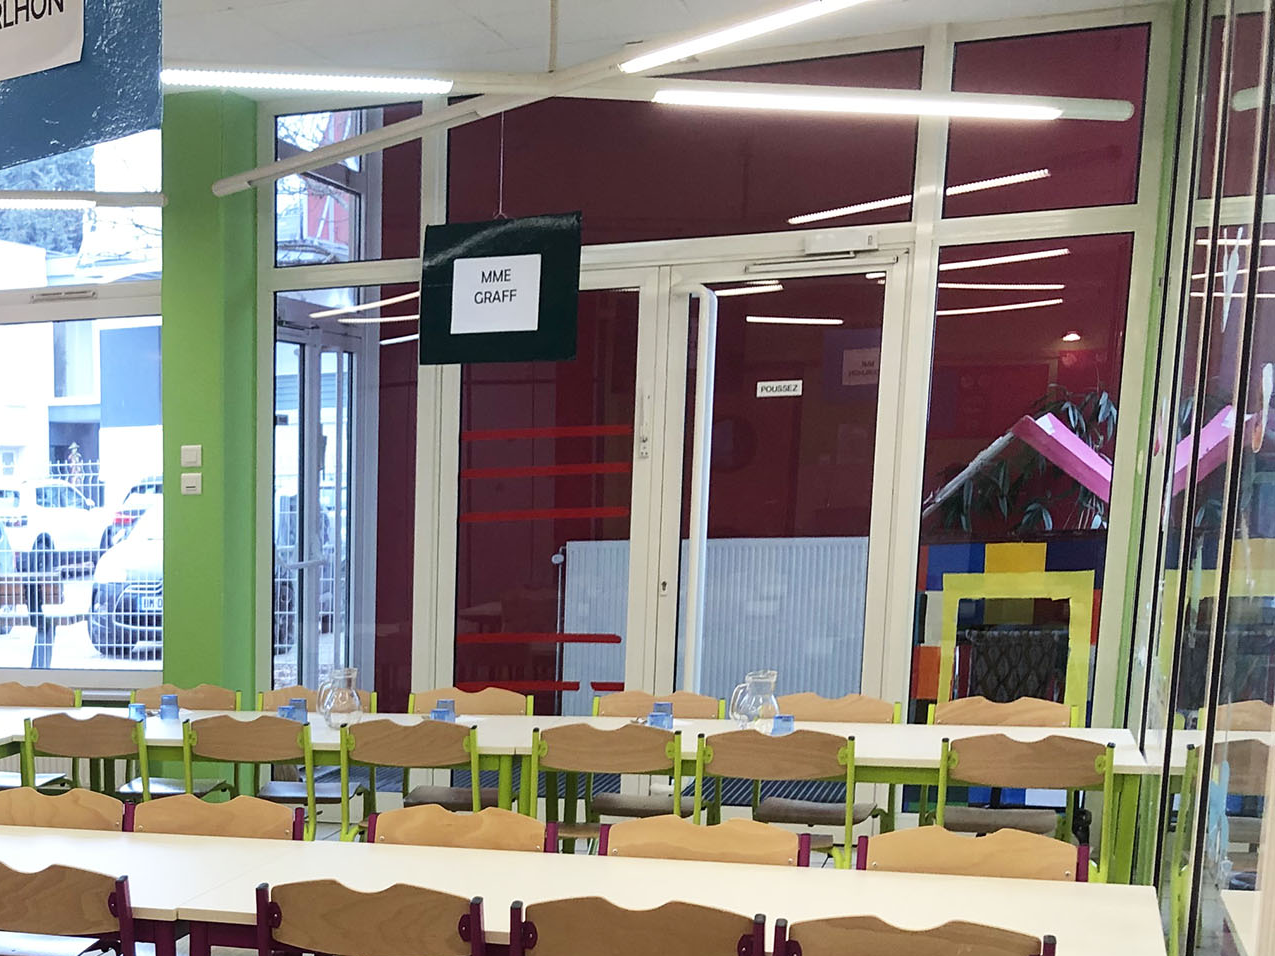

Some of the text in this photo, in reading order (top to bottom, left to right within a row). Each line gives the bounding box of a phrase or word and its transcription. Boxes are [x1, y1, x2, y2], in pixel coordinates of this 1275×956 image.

[481, 269, 511, 283] MME
[474, 289, 517, 304] GRAFF
[760, 384, 798, 393] POUSSEZ
